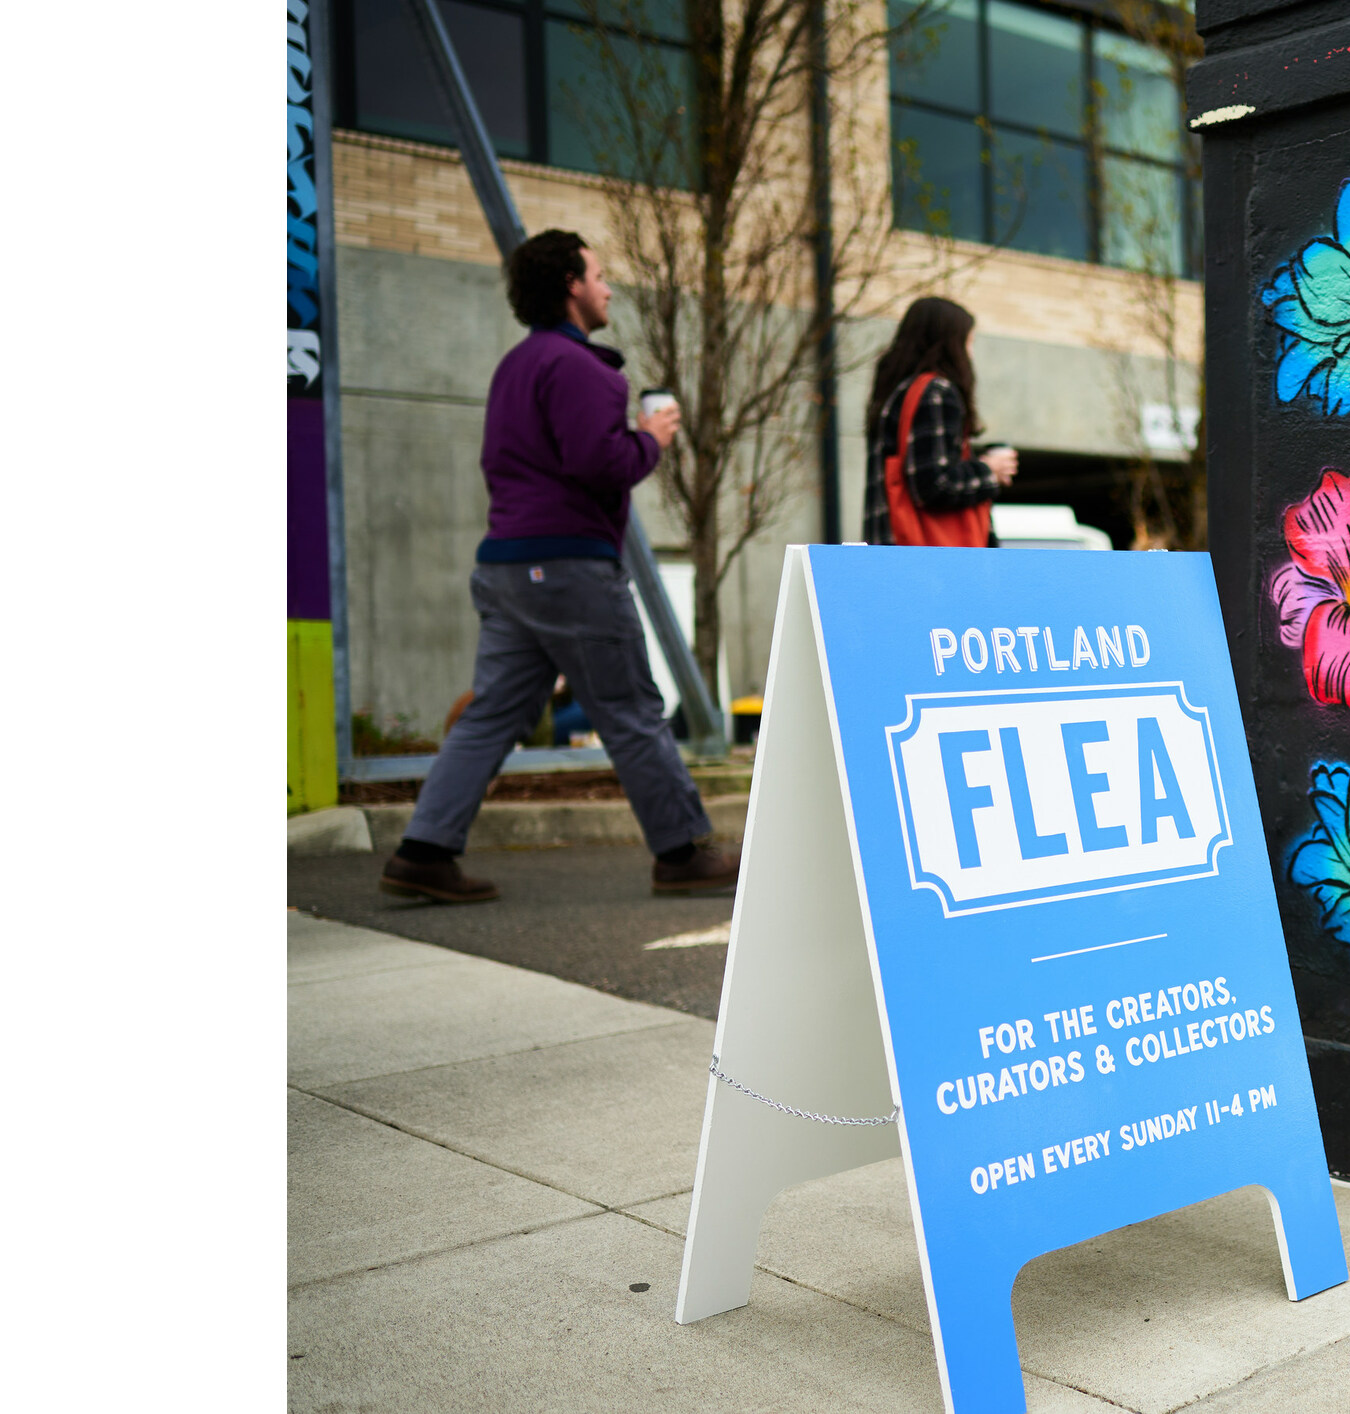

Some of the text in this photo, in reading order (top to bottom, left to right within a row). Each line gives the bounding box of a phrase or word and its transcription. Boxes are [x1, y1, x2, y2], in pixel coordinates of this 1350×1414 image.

[930, 624, 1151, 676] PORTLAND
[937, 716, 1197, 869] FLEA
[936, 1005, 1276, 1115] CURATORS & COLLECTORS
[978, 976, 1237, 1059] FOR THE CREATORS,
[970, 1084, 1278, 1195] OPEN EVERY SUNDAY 11-4 PM
